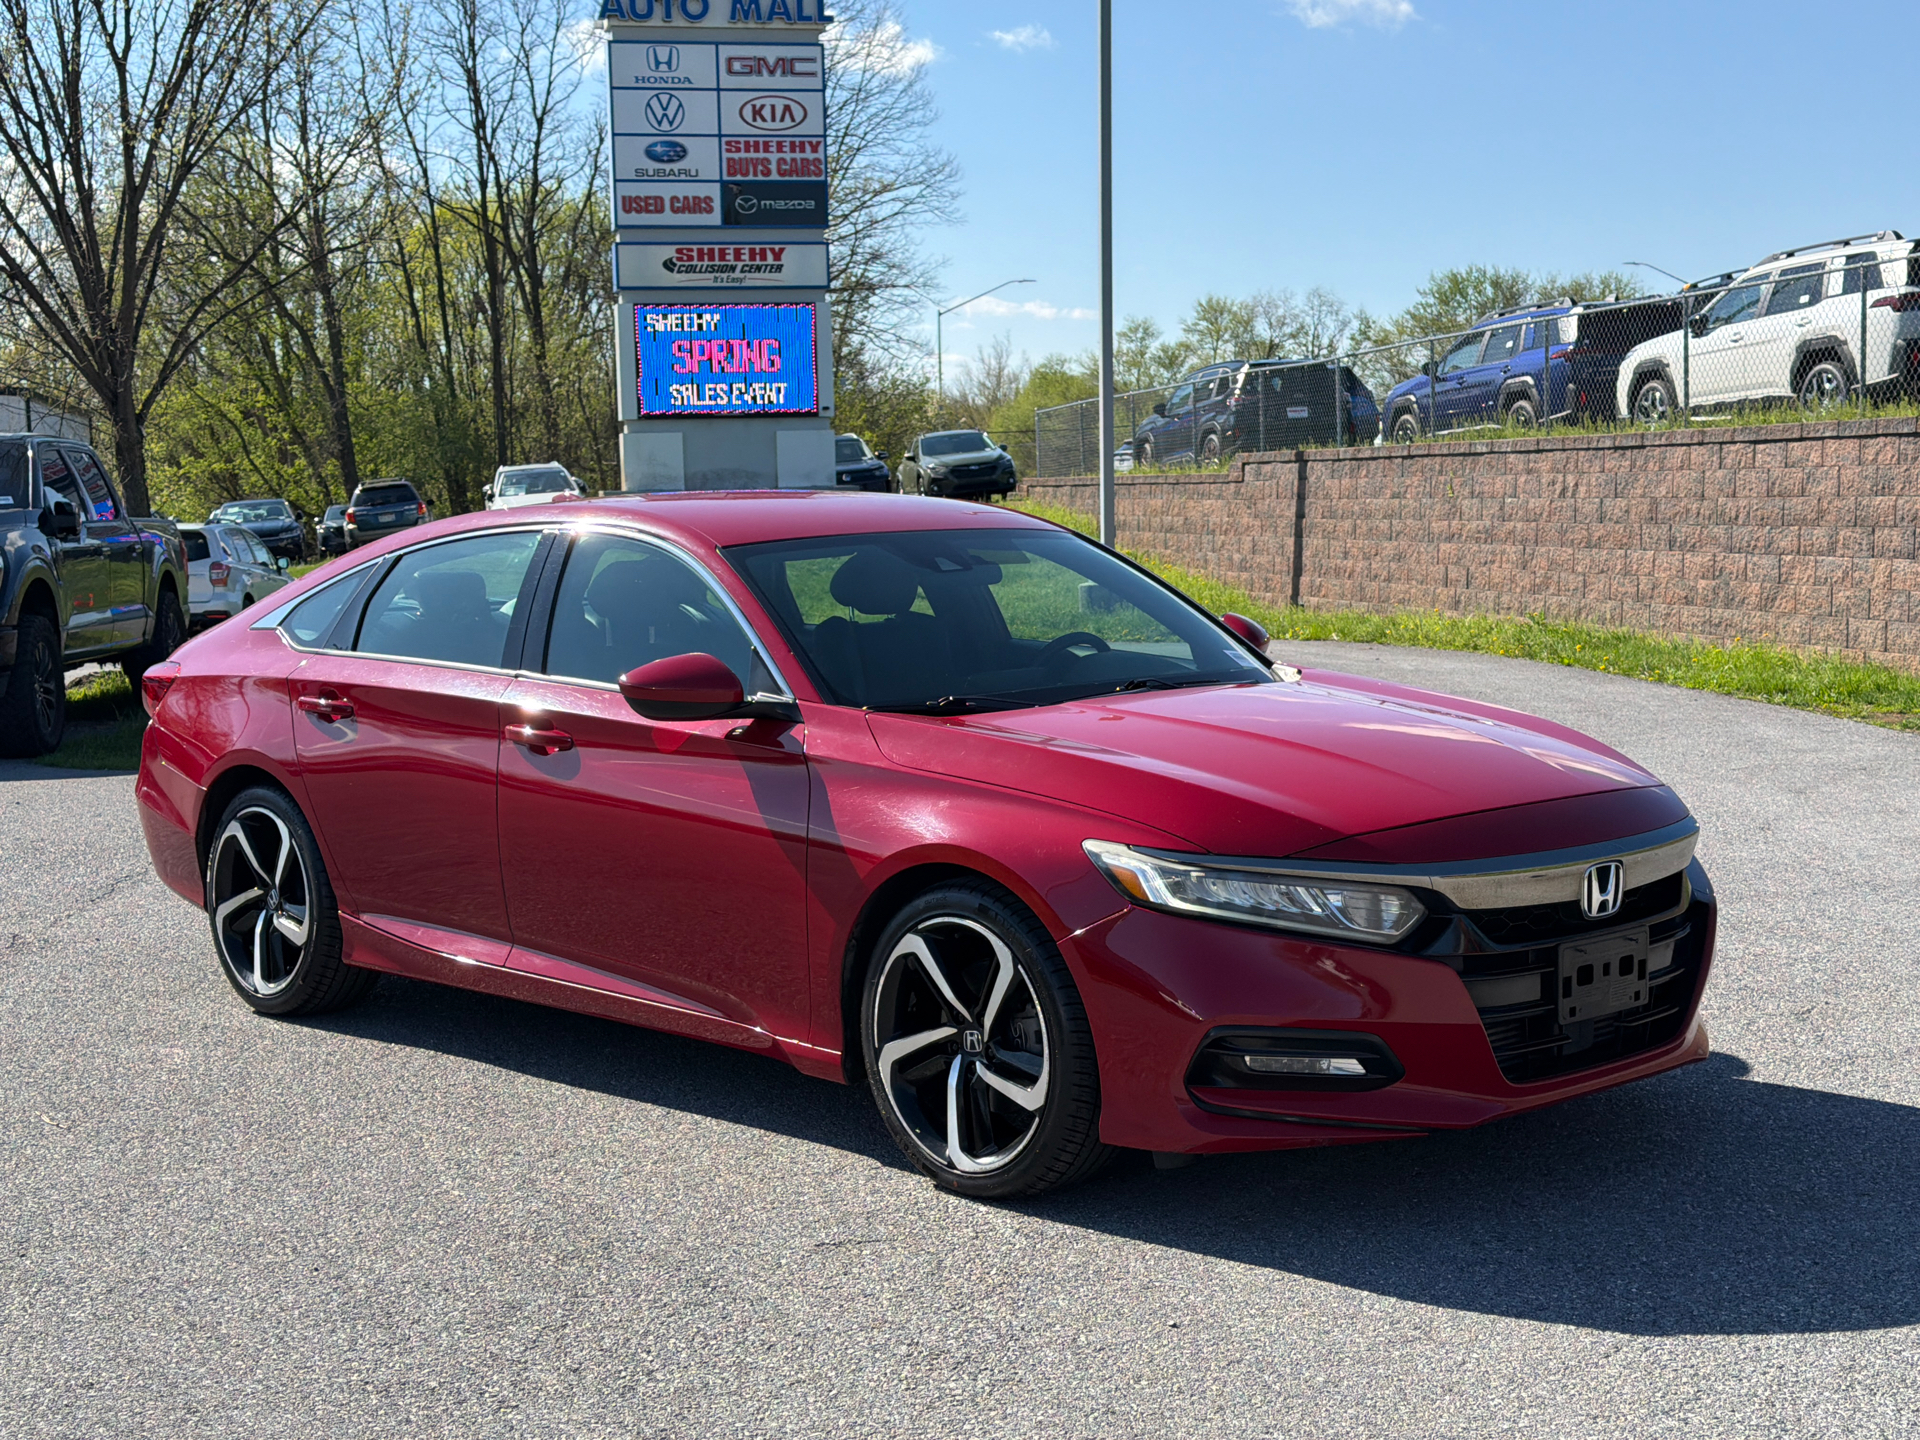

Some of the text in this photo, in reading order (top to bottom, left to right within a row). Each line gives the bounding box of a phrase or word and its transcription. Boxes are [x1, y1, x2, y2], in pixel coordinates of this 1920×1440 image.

[599, 0, 834, 23] AUTO MALL
[725, 56, 818, 77] GMC
[633, 76, 694, 85] HONDA
[751, 104, 797, 123] KIA
[724, 140, 823, 154] SHEEHY
[634, 168, 699, 178] SUBARU
[726, 157, 824, 178] BUYS CARS
[621, 195, 715, 215] USED CARS
[675, 247, 787, 262] SHEEHY
[676, 264, 784, 274] COLLISION CENTER
[713, 275, 747, 285] It's Easy!
[646, 313, 720, 332] SHEEHY
[672, 339, 781, 374] SPRING
[669, 382, 787, 405] SALES EVENT
